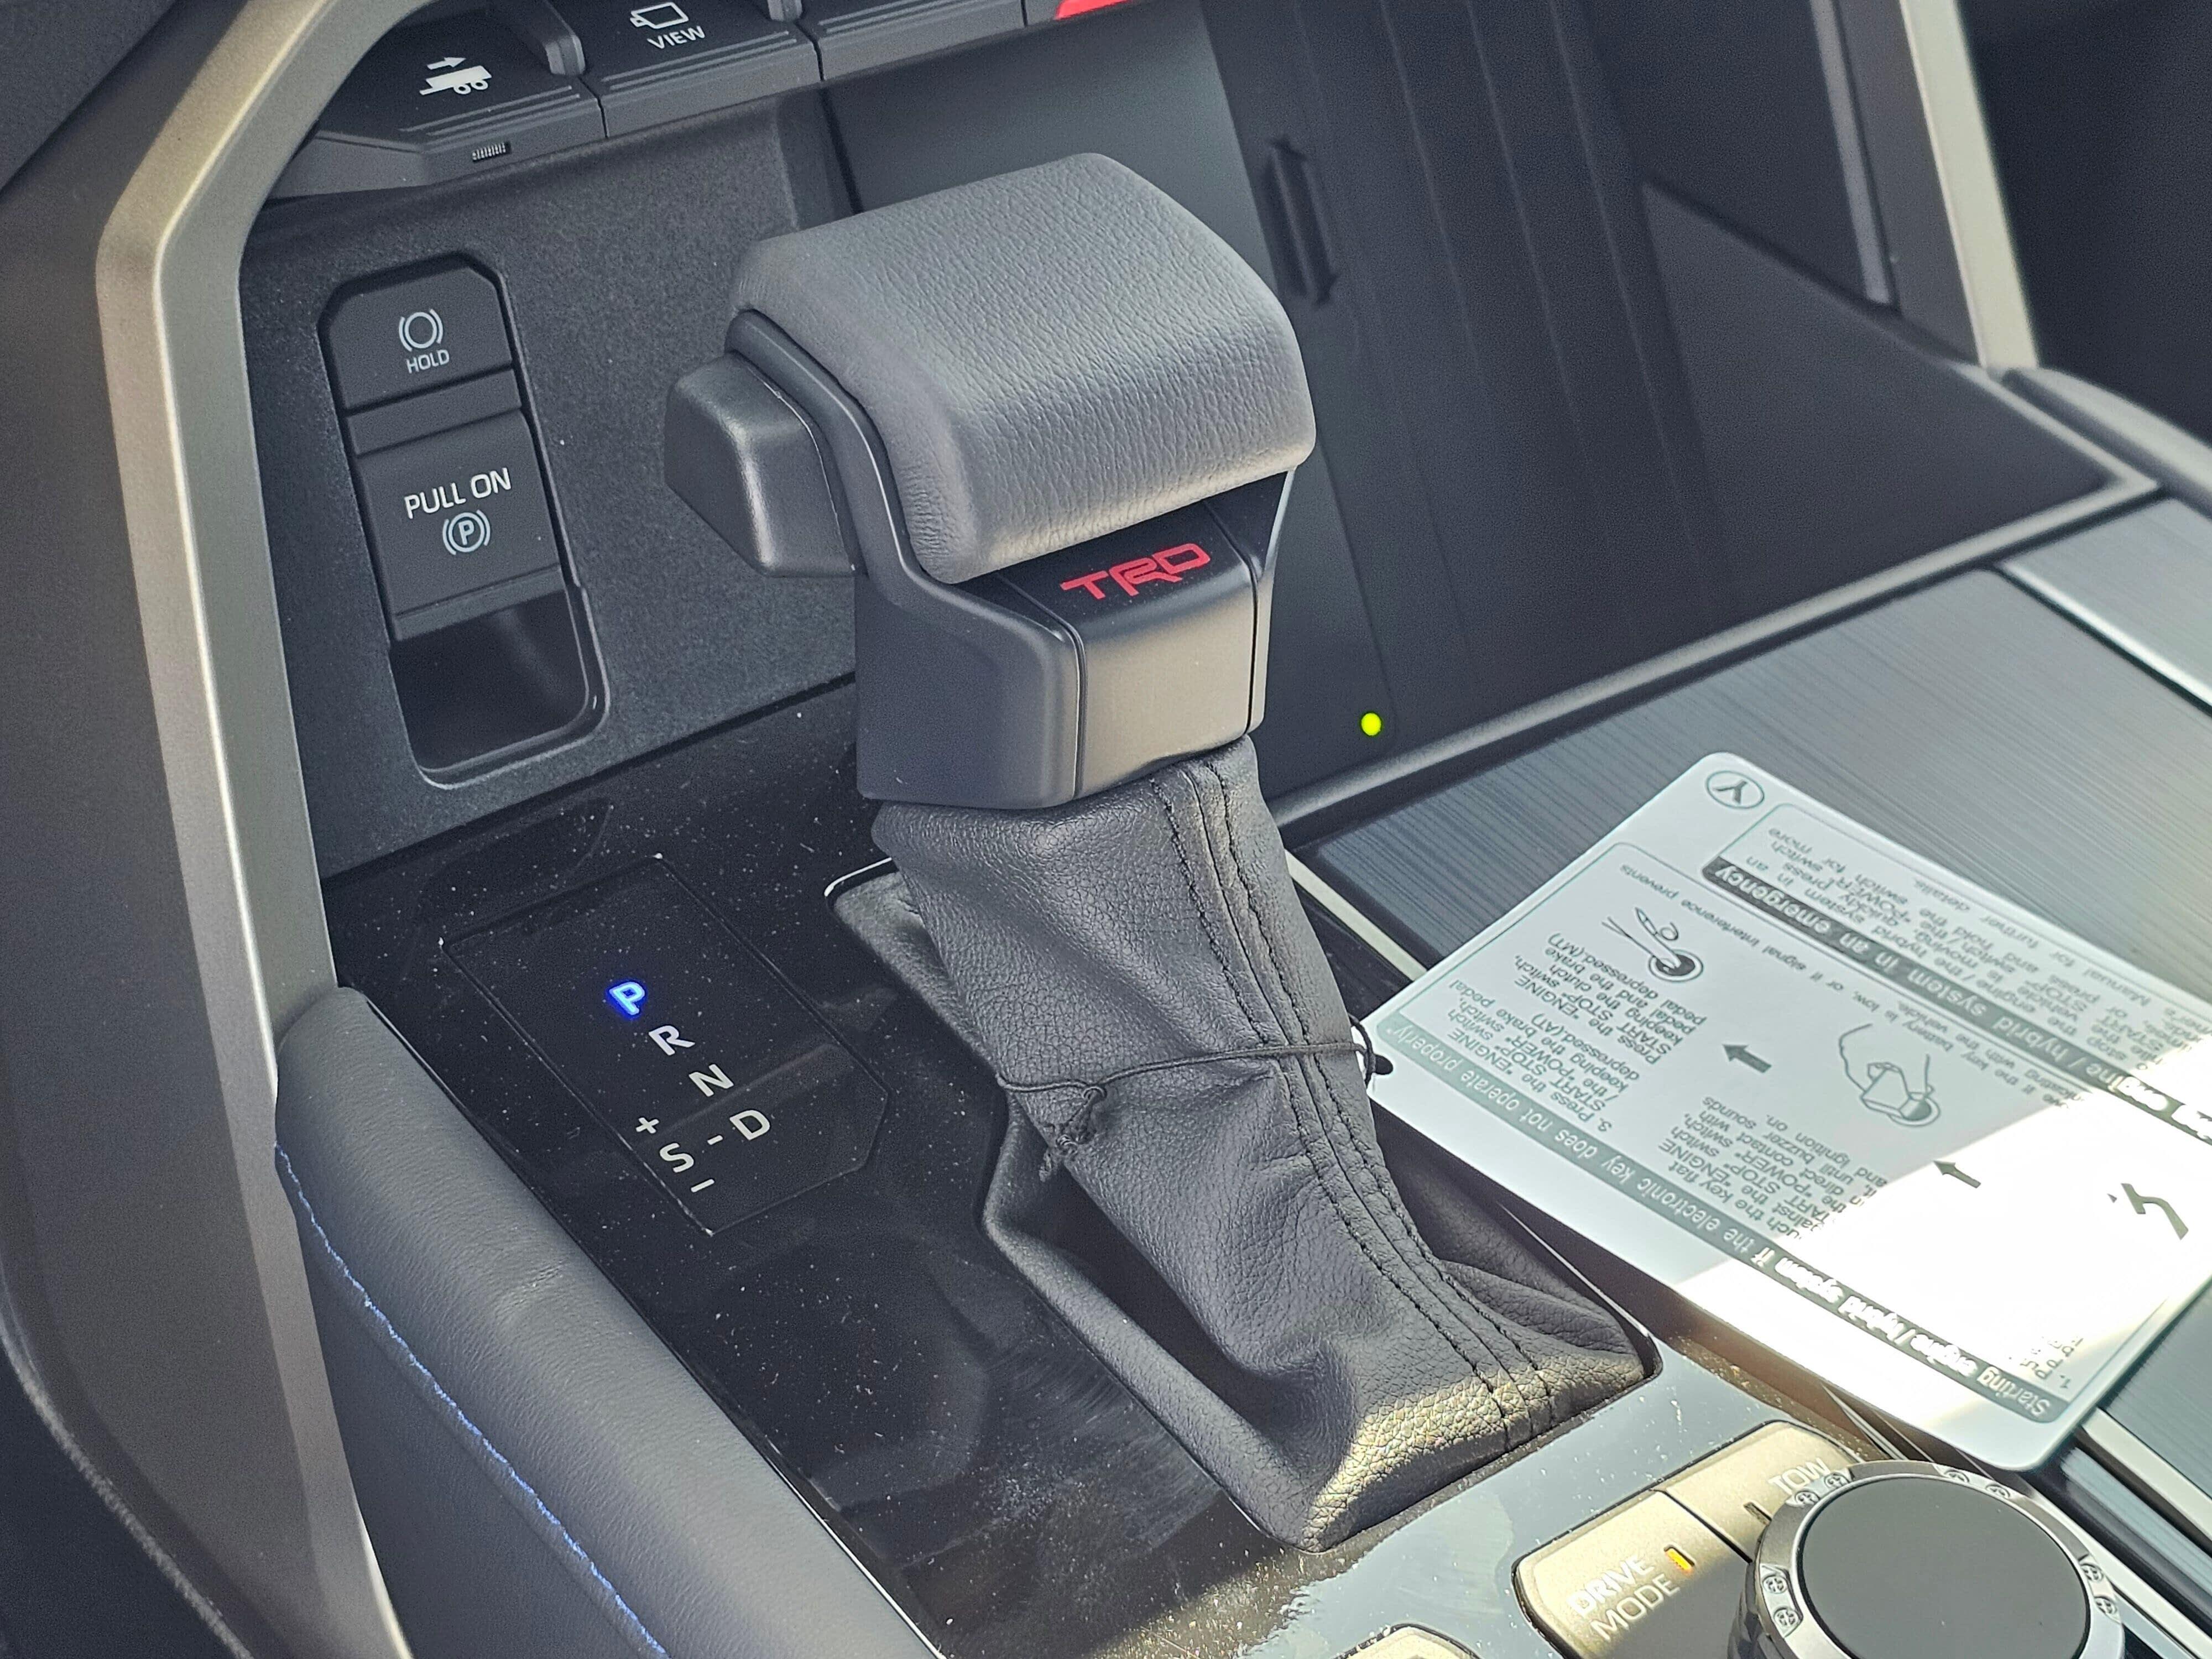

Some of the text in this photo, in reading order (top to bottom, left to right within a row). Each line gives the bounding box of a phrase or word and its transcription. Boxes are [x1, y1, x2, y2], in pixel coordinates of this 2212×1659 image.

[649, 25, 706, 50] VIEW
[405, 349, 450, 373] HOLD
[403, 467, 512, 519] PULL ON
[1060, 543, 1211, 599] TRD
[1767, 827, 1812, 854] more
[1770, 840, 1823, 872] switch
[1745, 855, 1769, 871] an
[1776, 873, 1794, 887] in
[1782, 856, 1836, 891] press
[1822, 858, 1846, 873] for
[1619, 864, 1679, 900] prevents
[1854, 873, 1908, 905] switch
[1714, 865, 1832, 934] emergency
[1803, 887, 1865, 924] system
[1837, 890, 1899, 927] quickly
[1680, 899, 1760, 947] interference
[1918, 908, 1948, 927] the
[1979, 915, 2039, 949] further
[1839, 932, 1869, 954] an
[1870, 925, 1928, 959] hybrid
[1951, 926, 1994, 952] hold
[1761, 945, 1807, 971] signal
[1875, 952, 1898, 972] in
[2002, 952, 2039, 973] and
[2048, 951, 2075, 968] for
[1544, 948, 1697, 1036] pedal and the brake
[1809, 972, 1823, 981] if
[1825, 980, 1844, 992] or
[1907, 968, 1987, 1016] system
[1986, 969, 2004, 984] is
[2048, 974, 2101, 1005] press
[2081, 968, 2152, 1008] Manual
[608, 981, 646, 1016] P
[1458, 997, 1505, 1032] switch,
[1514, 954, 1672, 1055] START STOP" switch,
[1548, 964, 1683, 1047] keeping the clutch
[1659, 999, 1708, 1026] pedal
[1852, 990, 1880, 1013] low,
[2016, 985, 2079, 1022] vehicle
[2105, 1006, 2128, 1019] or
[1514, 974, 1662, 1065] Press the "ENGINE
[1884, 1009, 1899, 1023] is
[2047, 1016, 2078, 1037] the
[649, 1025, 695, 1056] R
[1448, 979, 1629, 1093] keeping the brake pedal
[1898, 1000, 2084, 1100] nicating with the vehicle.
[1901, 1019, 1954, 1053] battery
[1991, 1016, 2069, 1062] hybrid
[2085, 1036, 2128, 1061] stop
[2090, 1024, 2121, 1045] the
[2096, 1015, 2164, 1052] START
[1447, 1008, 1606, 1112] START STOP" switch
[1504, 1035, 1575, 1081] "POWER"
[1960, 1050, 1990, 1071] key
[689, 1064, 734, 1097] N
[1446, 1027, 1613, 1132] 3. Press the "ENGINE
[1460, 1070, 1520, 1111] operate
[1994, 1068, 2019, 1086] the
[1519, 1108, 1553, 1132] not
[659, 1142, 695, 1173] S
[730, 1109, 770, 1141] D
[1554, 1129, 1598, 1159] does
[1698, 1110, 1864, 1206] in direct contact with
[1702, 1096, 1877, 1197] it, until buzzer sounds
[1765, 1114, 1888, 1188] and ignition on.
[1600, 1155, 1635, 1184] key
[1657, 1138, 1731, 1187] "ENGINE
[1670, 1125, 1830, 1224] TART STOP" switch
[1683, 1113, 1847, 1213] the "POWER" switch,
[1636, 1177, 1721, 1231] electronic
[1668, 1160, 1801, 1239] uch the key flat
[1740, 1185, 1769, 1206] the
[1723, 1228, 1755, 1253] the
[1750, 1246, 1775, 1268] if
[1976, 1365, 2051, 1416] Starting
[2059, 1374, 2071, 1389] 1.
[1768, 1458, 1829, 1494] TOW
[1567, 1554, 1655, 1616] DRIVE
[1590, 1573, 1680, 1642] MODE
